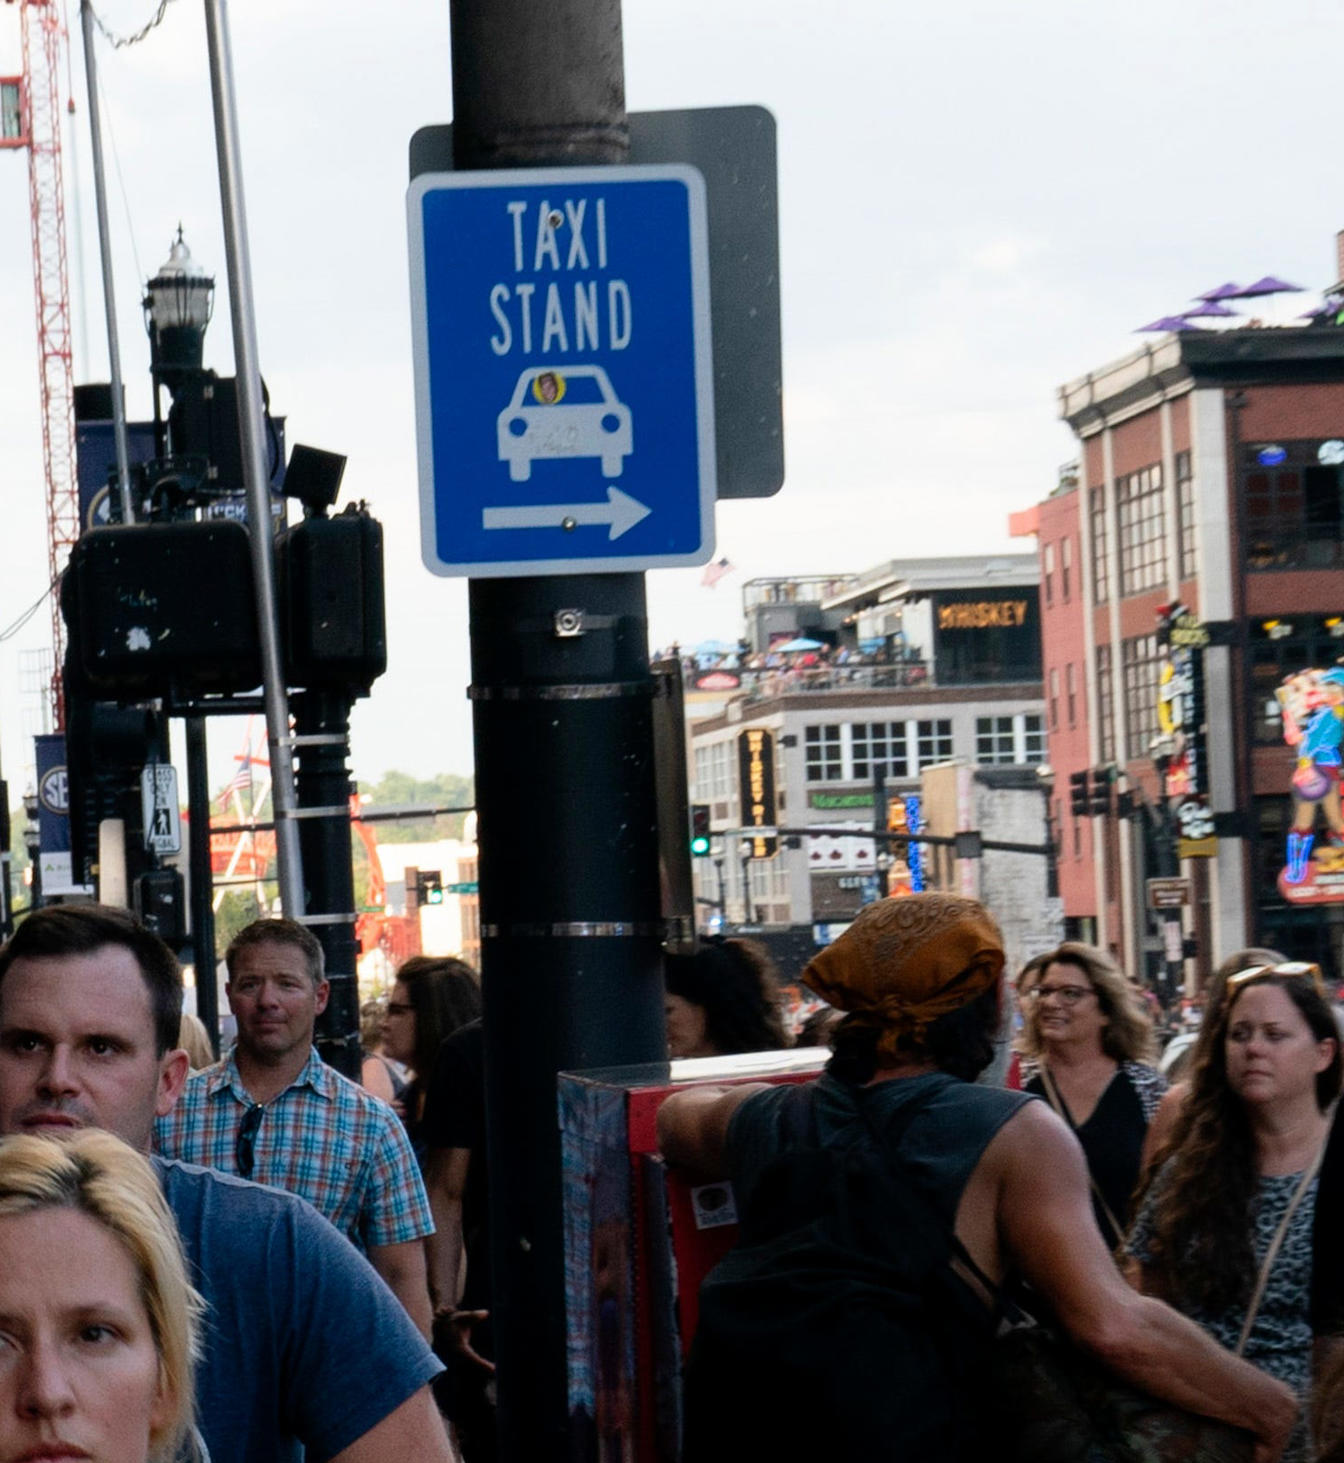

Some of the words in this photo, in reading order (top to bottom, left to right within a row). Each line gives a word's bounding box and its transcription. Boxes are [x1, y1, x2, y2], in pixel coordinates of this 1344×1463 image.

[506, 197, 609, 272] TAXI
[490, 278, 633, 357] STAND
[43, 770, 69, 810] SE
